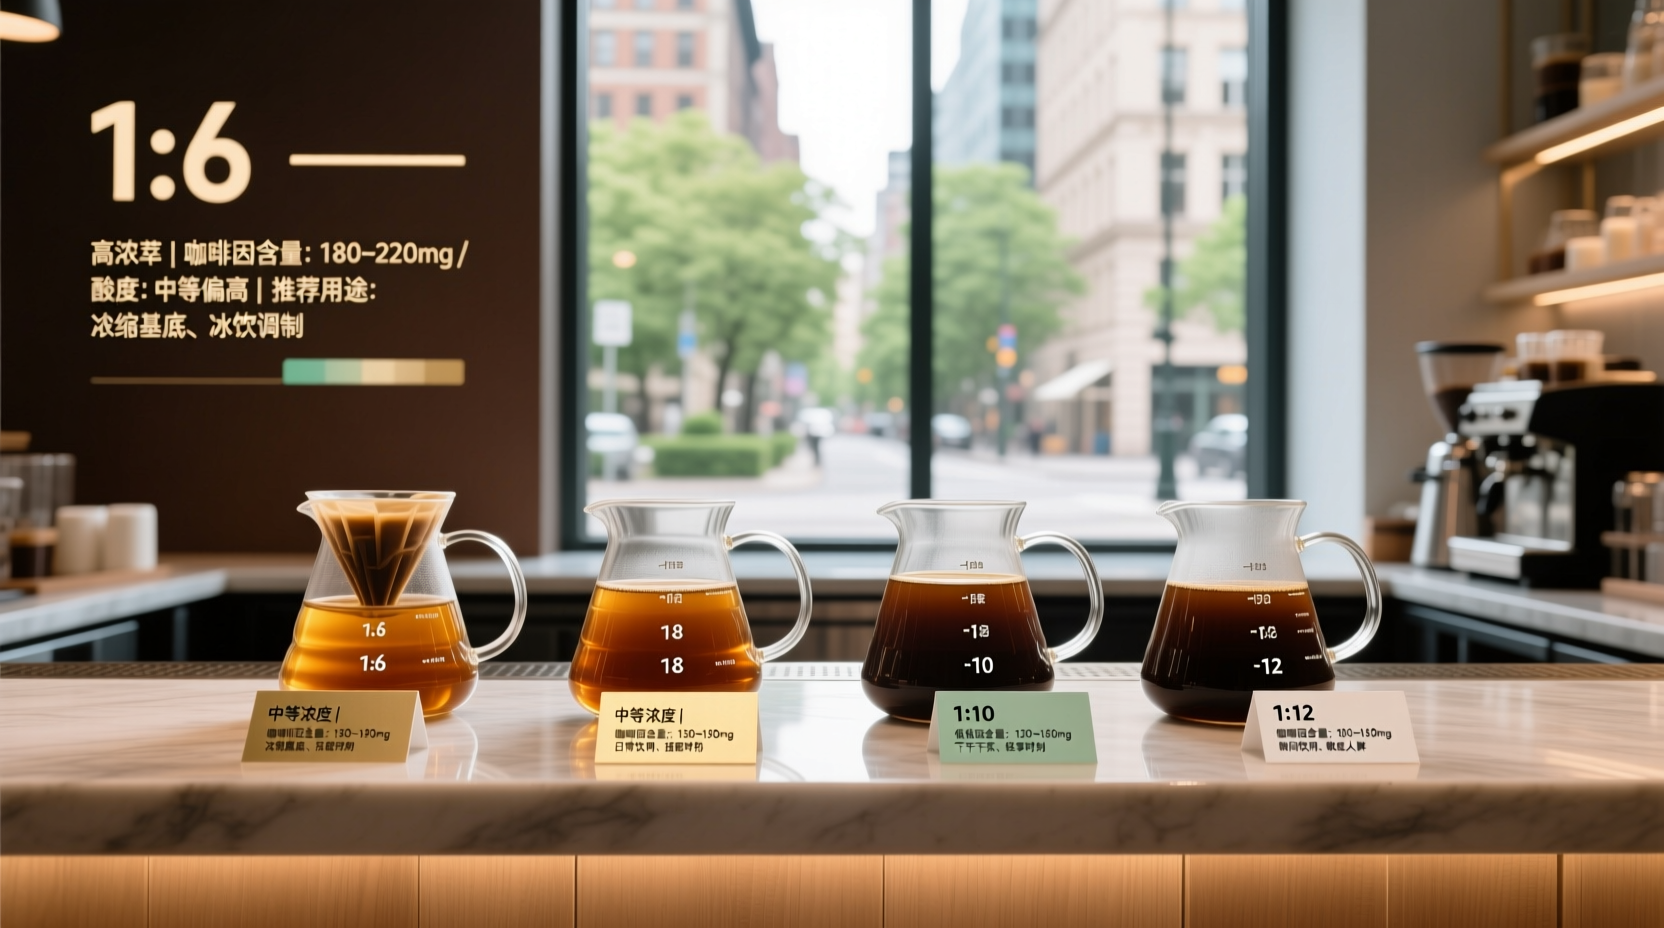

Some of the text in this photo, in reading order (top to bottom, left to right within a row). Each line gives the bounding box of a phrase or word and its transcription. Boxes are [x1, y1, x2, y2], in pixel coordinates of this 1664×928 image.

[90, 100, 252, 204] 1:6
[359, 653, 387, 672] 1:6
[660, 656, 684, 674] 18
[953, 705, 995, 722] 1:10
[1272, 704, 1315, 722] 1:12
